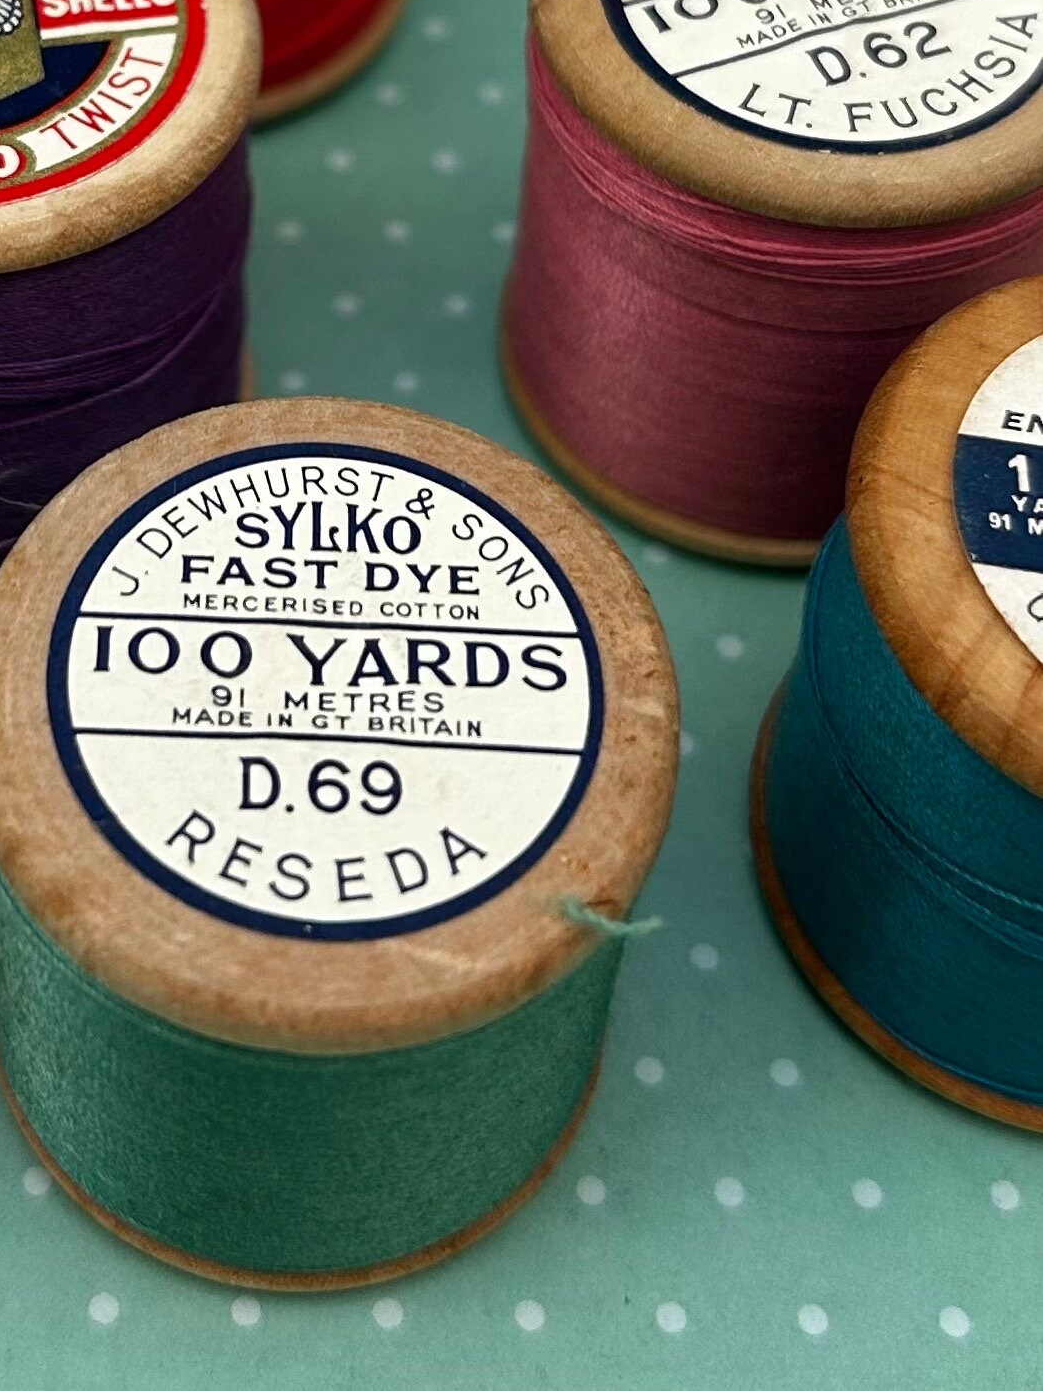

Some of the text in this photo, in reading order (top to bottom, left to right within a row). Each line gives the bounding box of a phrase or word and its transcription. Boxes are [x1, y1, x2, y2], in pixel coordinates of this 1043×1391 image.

[736, 18, 803, 50] MADE
[807, 12, 834, 27] IN
[755, 3, 787, 25] 91
[739, 9, 1041, 134] LT. FUCHSIA
[805, 20, 953, 87] D.62
[39, 47, 165, 154] TWIST
[111, 465, 551, 612] J. DEWHURST & SONS
[235, 501, 423, 555] SYLKO
[988, 511, 1012, 531] 91
[181, 554, 481, 596] FAST DYE
[182, 592, 481, 621] MERCERISED COTTON
[93, 624, 569, 692] 100 YARDS
[172, 707, 483, 737] MADE IN GT BRITAIN
[211, 685, 445, 714] 91 METRES
[238, 755, 404, 817] D.69
[164, 810, 488, 903] RESEDA
